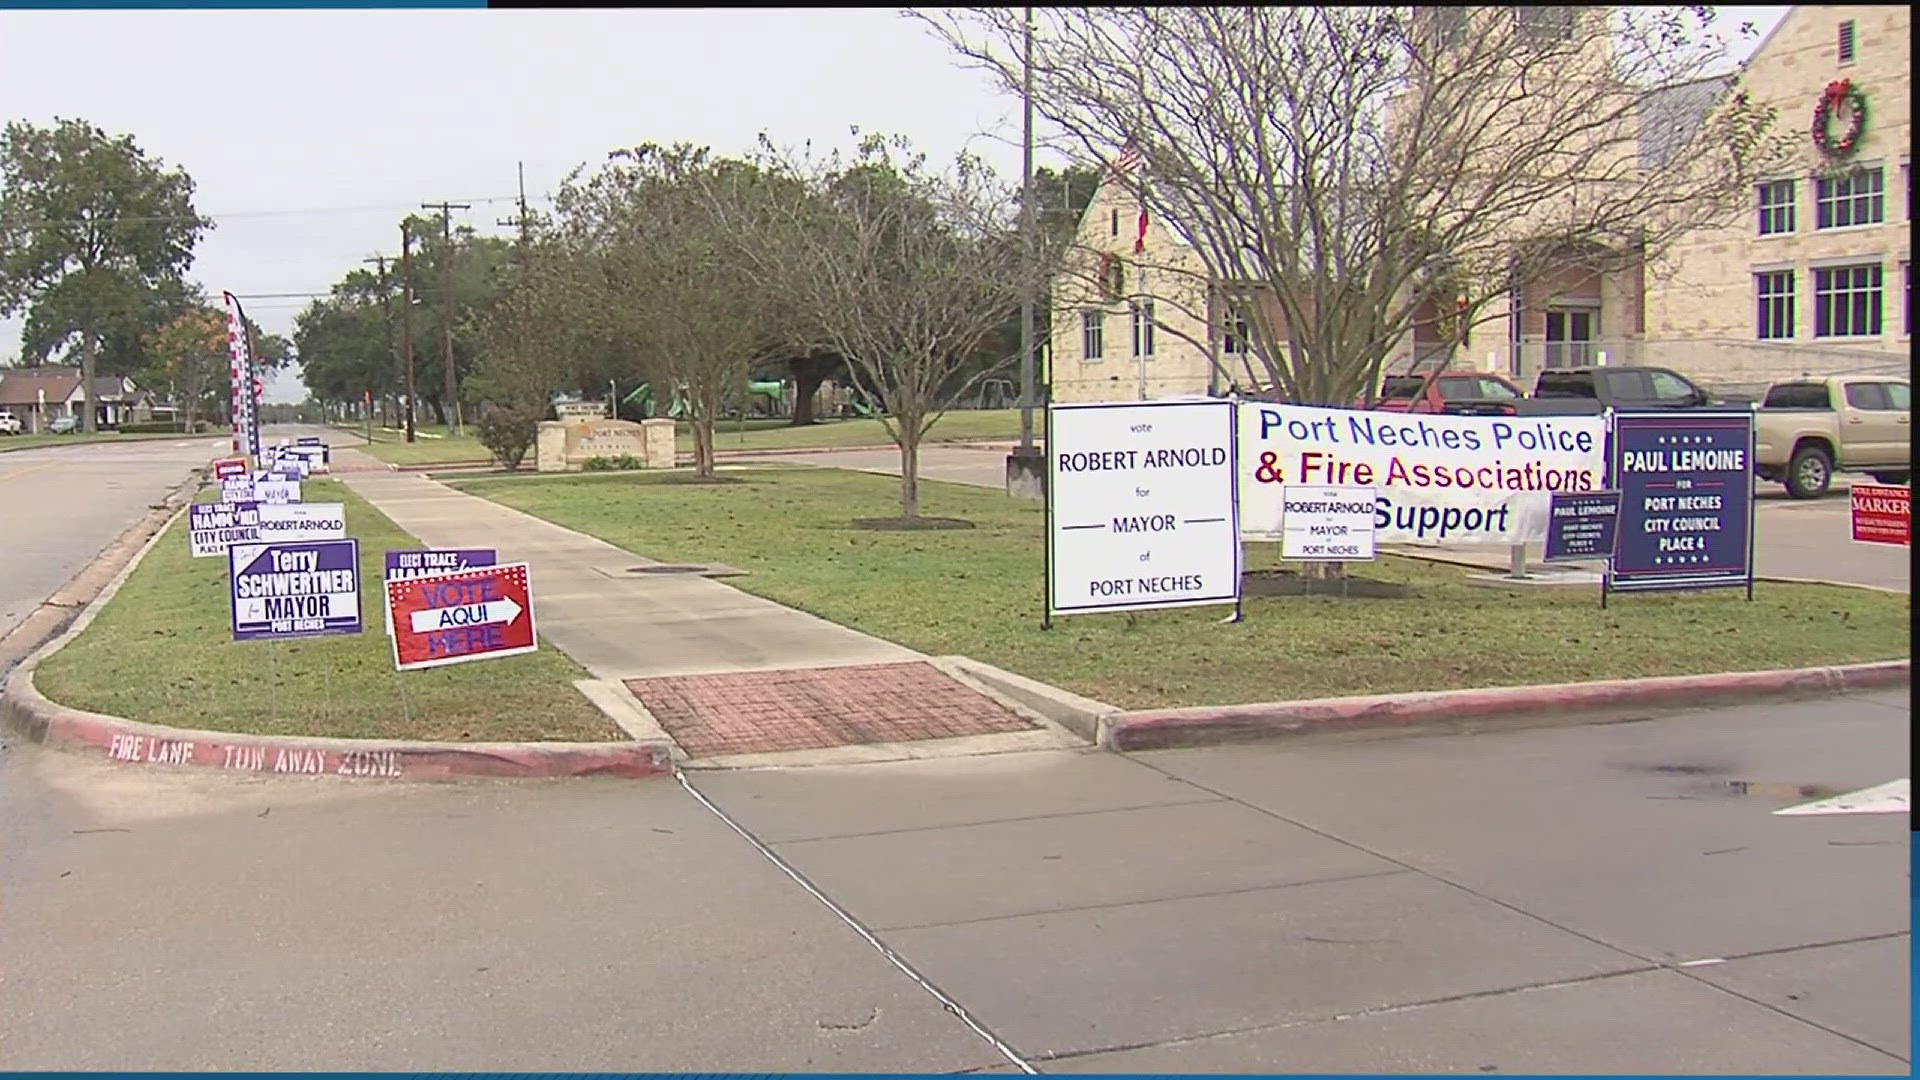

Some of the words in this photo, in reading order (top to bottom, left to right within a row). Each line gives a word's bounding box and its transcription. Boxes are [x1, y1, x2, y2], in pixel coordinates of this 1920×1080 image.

[1130, 423, 1153, 433] vote
[1260, 409, 1340, 443] Port
[1350, 416, 1481, 450] Neches
[1493, 422, 1593, 452] Police
[1059, 450, 1138, 472] ROBERT
[1144, 447, 1226, 469] ARNOLD
[1624, 451, 1668, 472] PAUL
[1672, 450, 1744, 471] LEMOINE
[1255, 451, 1284, 484] &
[1300, 452, 1374, 486] Fire
[1385, 457, 1592, 492] Associations
[1135, 487, 1150, 498] for
[1676, 480, 1692, 489] FOR
[1284, 502, 1327, 513] ROBERT
[1328, 502, 1374, 514] ARNOLD
[1554, 507, 1576, 516] PAUL
[1644, 498, 1676, 511] PORT
[1678, 496, 1722, 510] NECHES
[1853, 497, 1910, 514] MARKER
[259, 520, 298, 531] ROBERT
[299, 519, 343, 531] ARNOLD
[1112, 515, 1176, 534] MAYOR
[1375, 496, 1508, 538] Support
[1644, 518, 1670, 532] CITY
[1672, 517, 1720, 531] COUNCIL
[194, 531, 216, 545] CITY
[219, 528, 260, 543] COUNCIL
[1310, 525, 1348, 536] MAYOR
[1302, 545, 1325, 554] PORT
[1327, 545, 1359, 555] NECHES
[1660, 538, 1694, 551] PLACE
[1697, 537, 1705, 550] 4
[271, 549, 318, 573] Terry
[400, 553, 421, 567] ELECT
[424, 553, 457, 567] TRACE
[1139, 551, 1150, 562] of
[238, 569, 354, 598] SCHWERTNER
[1090, 577, 1133, 596] PORT
[1139, 575, 1203, 593] NECHES
[422, 578, 496, 608] VOTE
[265, 595, 330, 620] MAYOR
[439, 604, 489, 627] AQUI
[109, 734, 142, 761] FIRE
[274, 748, 326, 774] AWAY
[337, 750, 401, 777] ZONE
